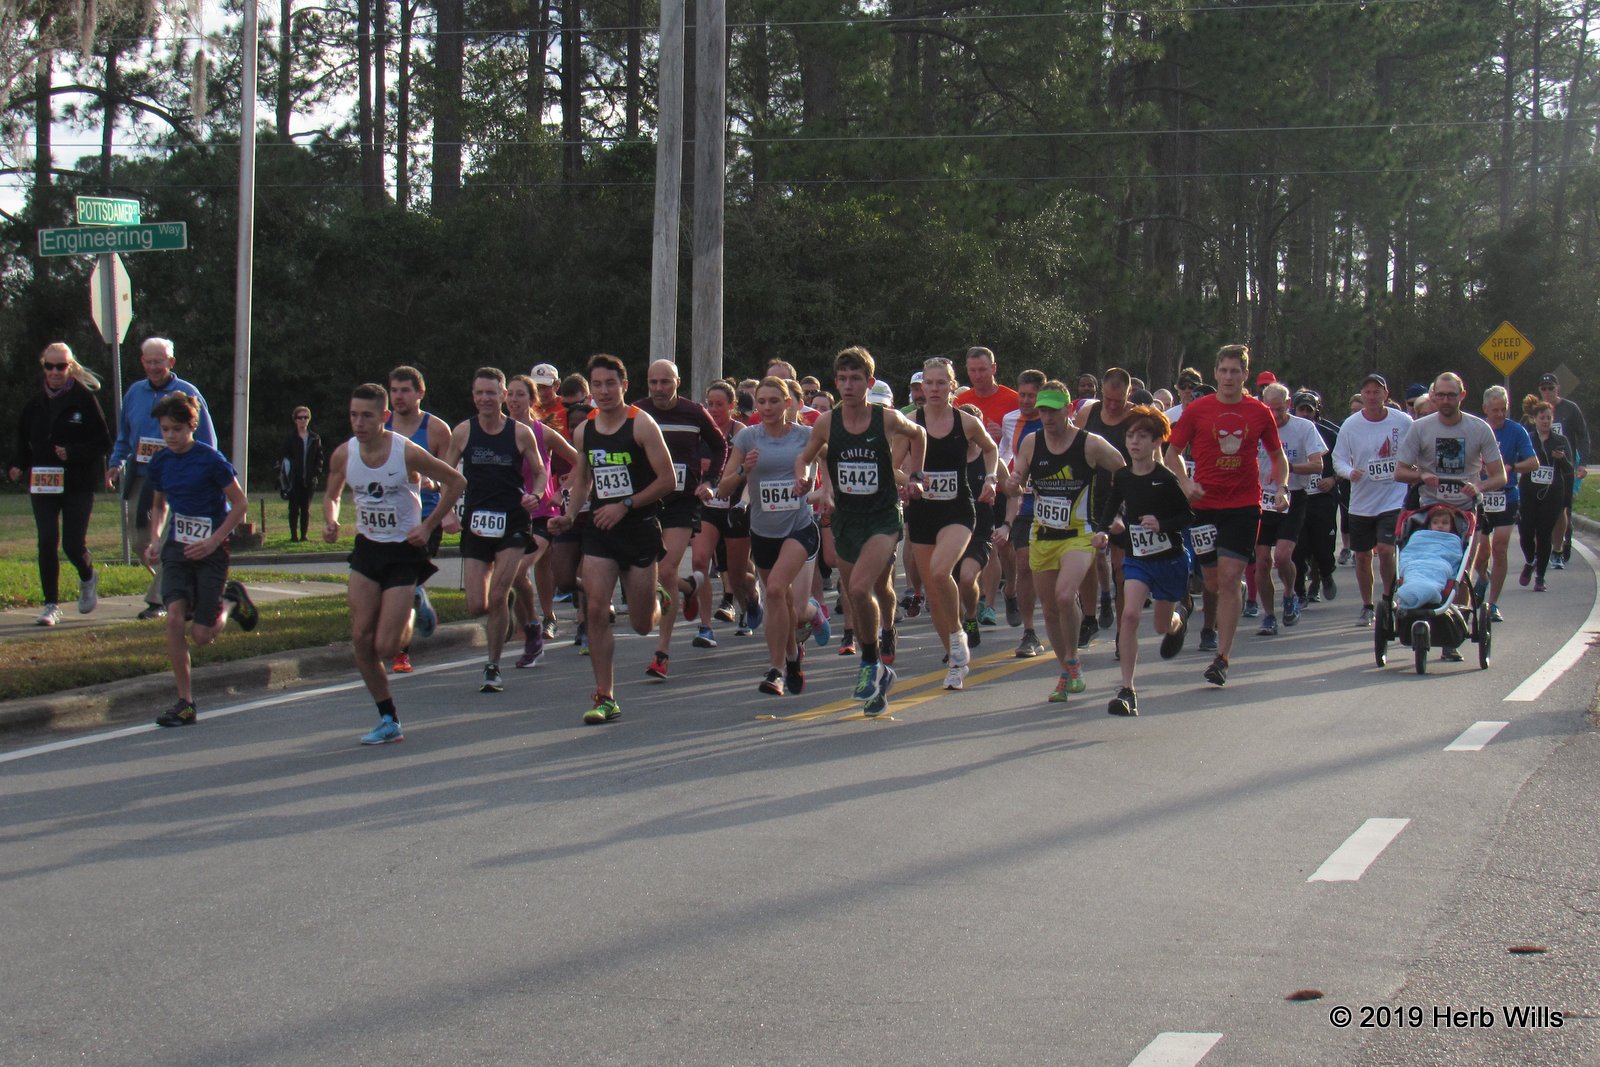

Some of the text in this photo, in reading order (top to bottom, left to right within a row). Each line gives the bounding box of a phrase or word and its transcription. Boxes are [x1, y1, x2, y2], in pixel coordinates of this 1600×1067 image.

[79, 200, 134, 223] POTTSDAMER
[41, 224, 181, 252] Engineering Way
[1491, 337, 1521, 348] SPEED
[1493, 351, 1520, 361] HUMP
[588, 449, 632, 466] iRun
[1368, 461, 1395, 476] 9646
[1531, 469, 1553, 480] 5479
[595, 472, 630, 490] 5433
[839, 469, 878, 486] 5442
[925, 478, 957, 492] 426
[761, 487, 798, 504] 9644
[360, 510, 397, 528] 5464
[1036, 502, 1069, 522] 9650
[176, 519, 210, 539] 9627
[471, 514, 505, 530] 5460
